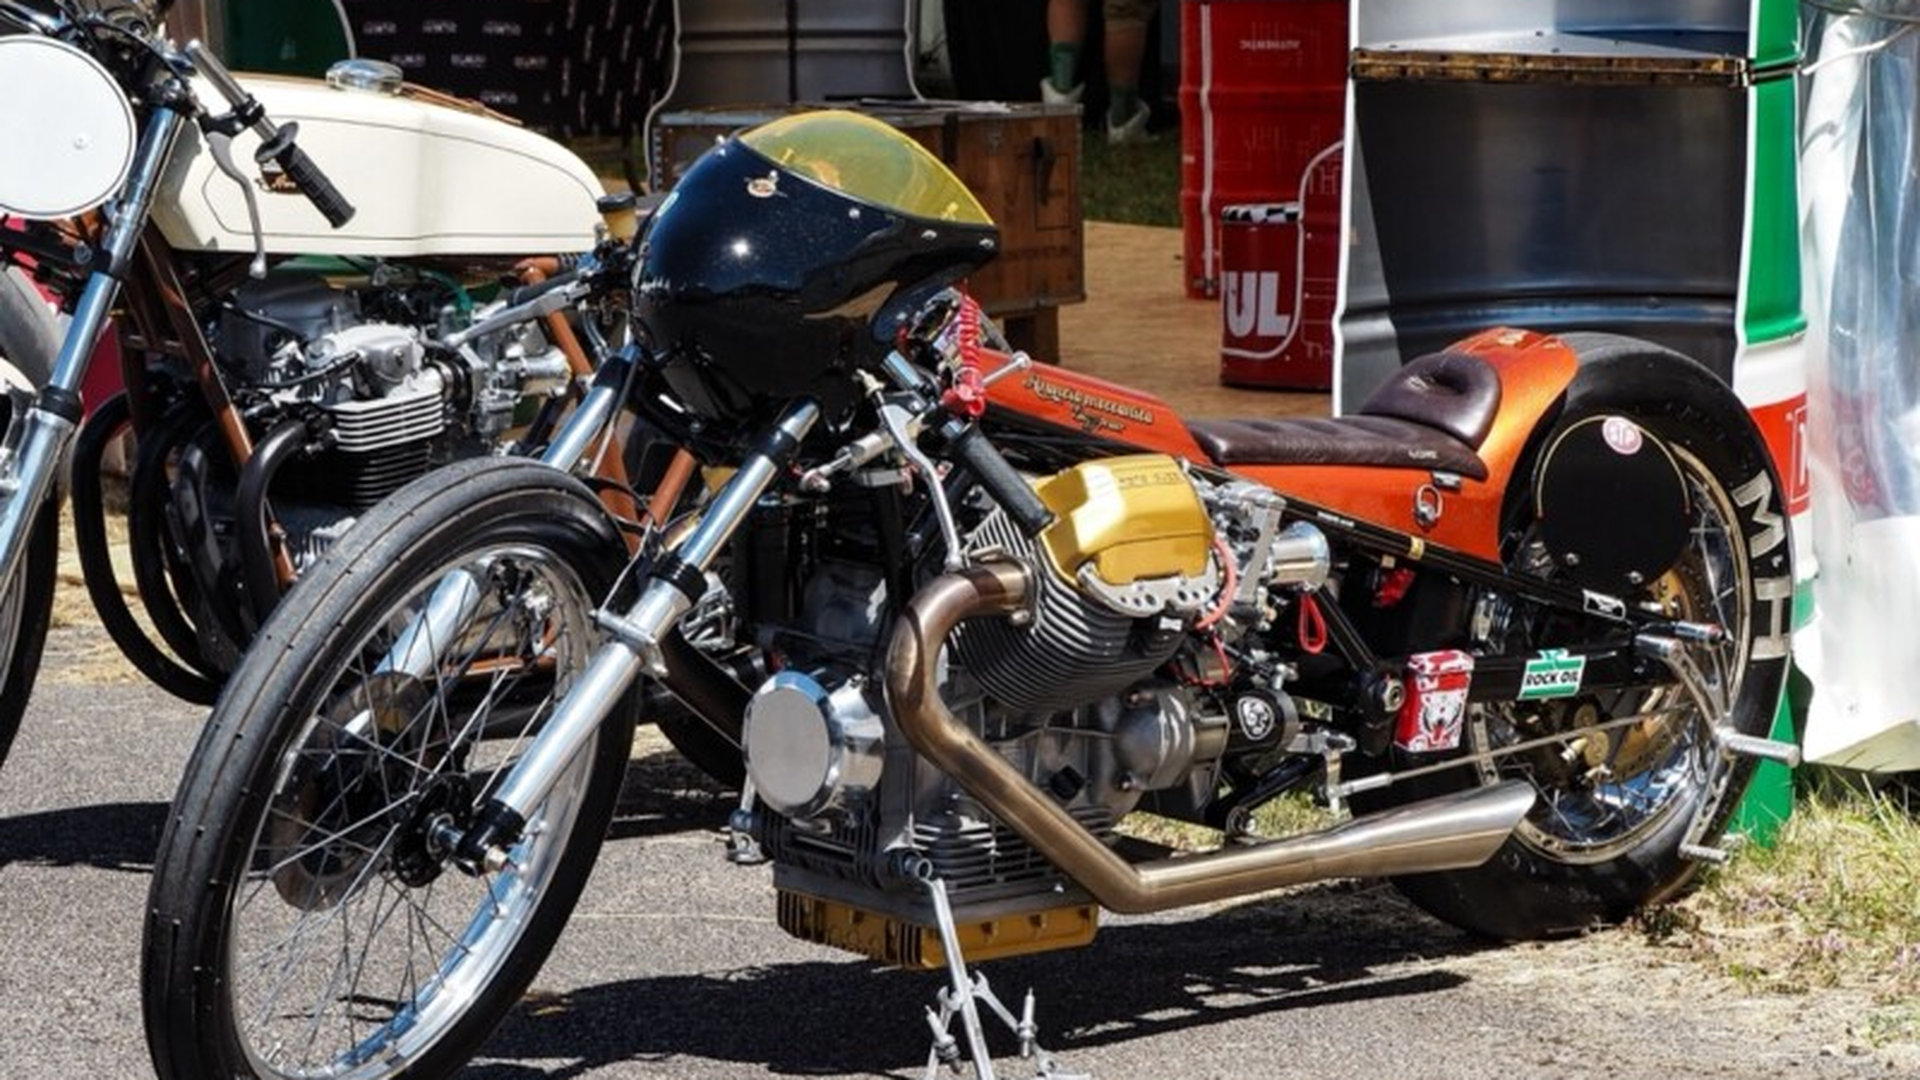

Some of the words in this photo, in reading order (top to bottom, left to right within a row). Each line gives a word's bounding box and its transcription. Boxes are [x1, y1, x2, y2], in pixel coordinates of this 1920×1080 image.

[1221, 271, 1291, 337] UL
[1525, 671, 1559, 686] ROCK
[1560, 671, 1579, 684] OIL
